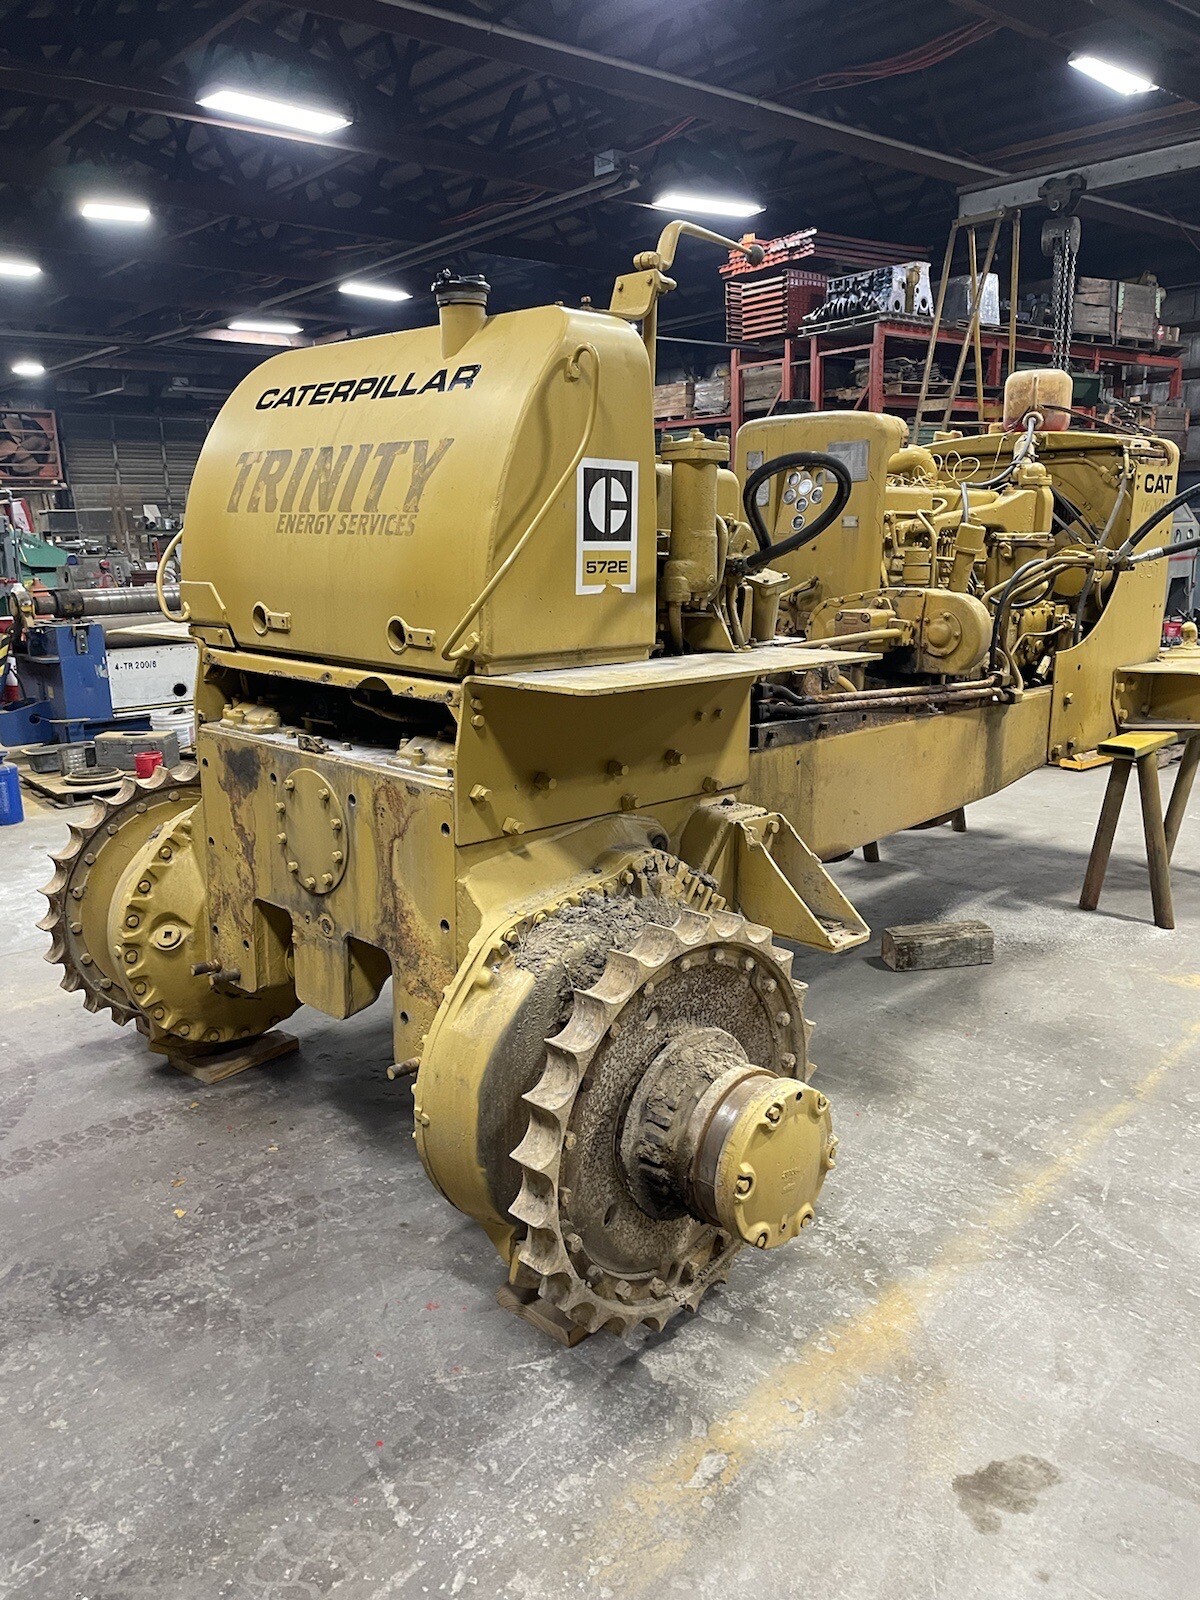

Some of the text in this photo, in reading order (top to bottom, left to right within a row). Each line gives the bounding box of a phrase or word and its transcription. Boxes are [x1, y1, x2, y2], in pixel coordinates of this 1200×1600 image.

[255, 364, 482, 410] CATERPILLAR
[226, 437, 454, 513] TRINITY
[1144, 473, 1173, 494] CAT
[276, 514, 417, 536] ENERGY SERVICES
[586, 560, 628, 574] 572E
